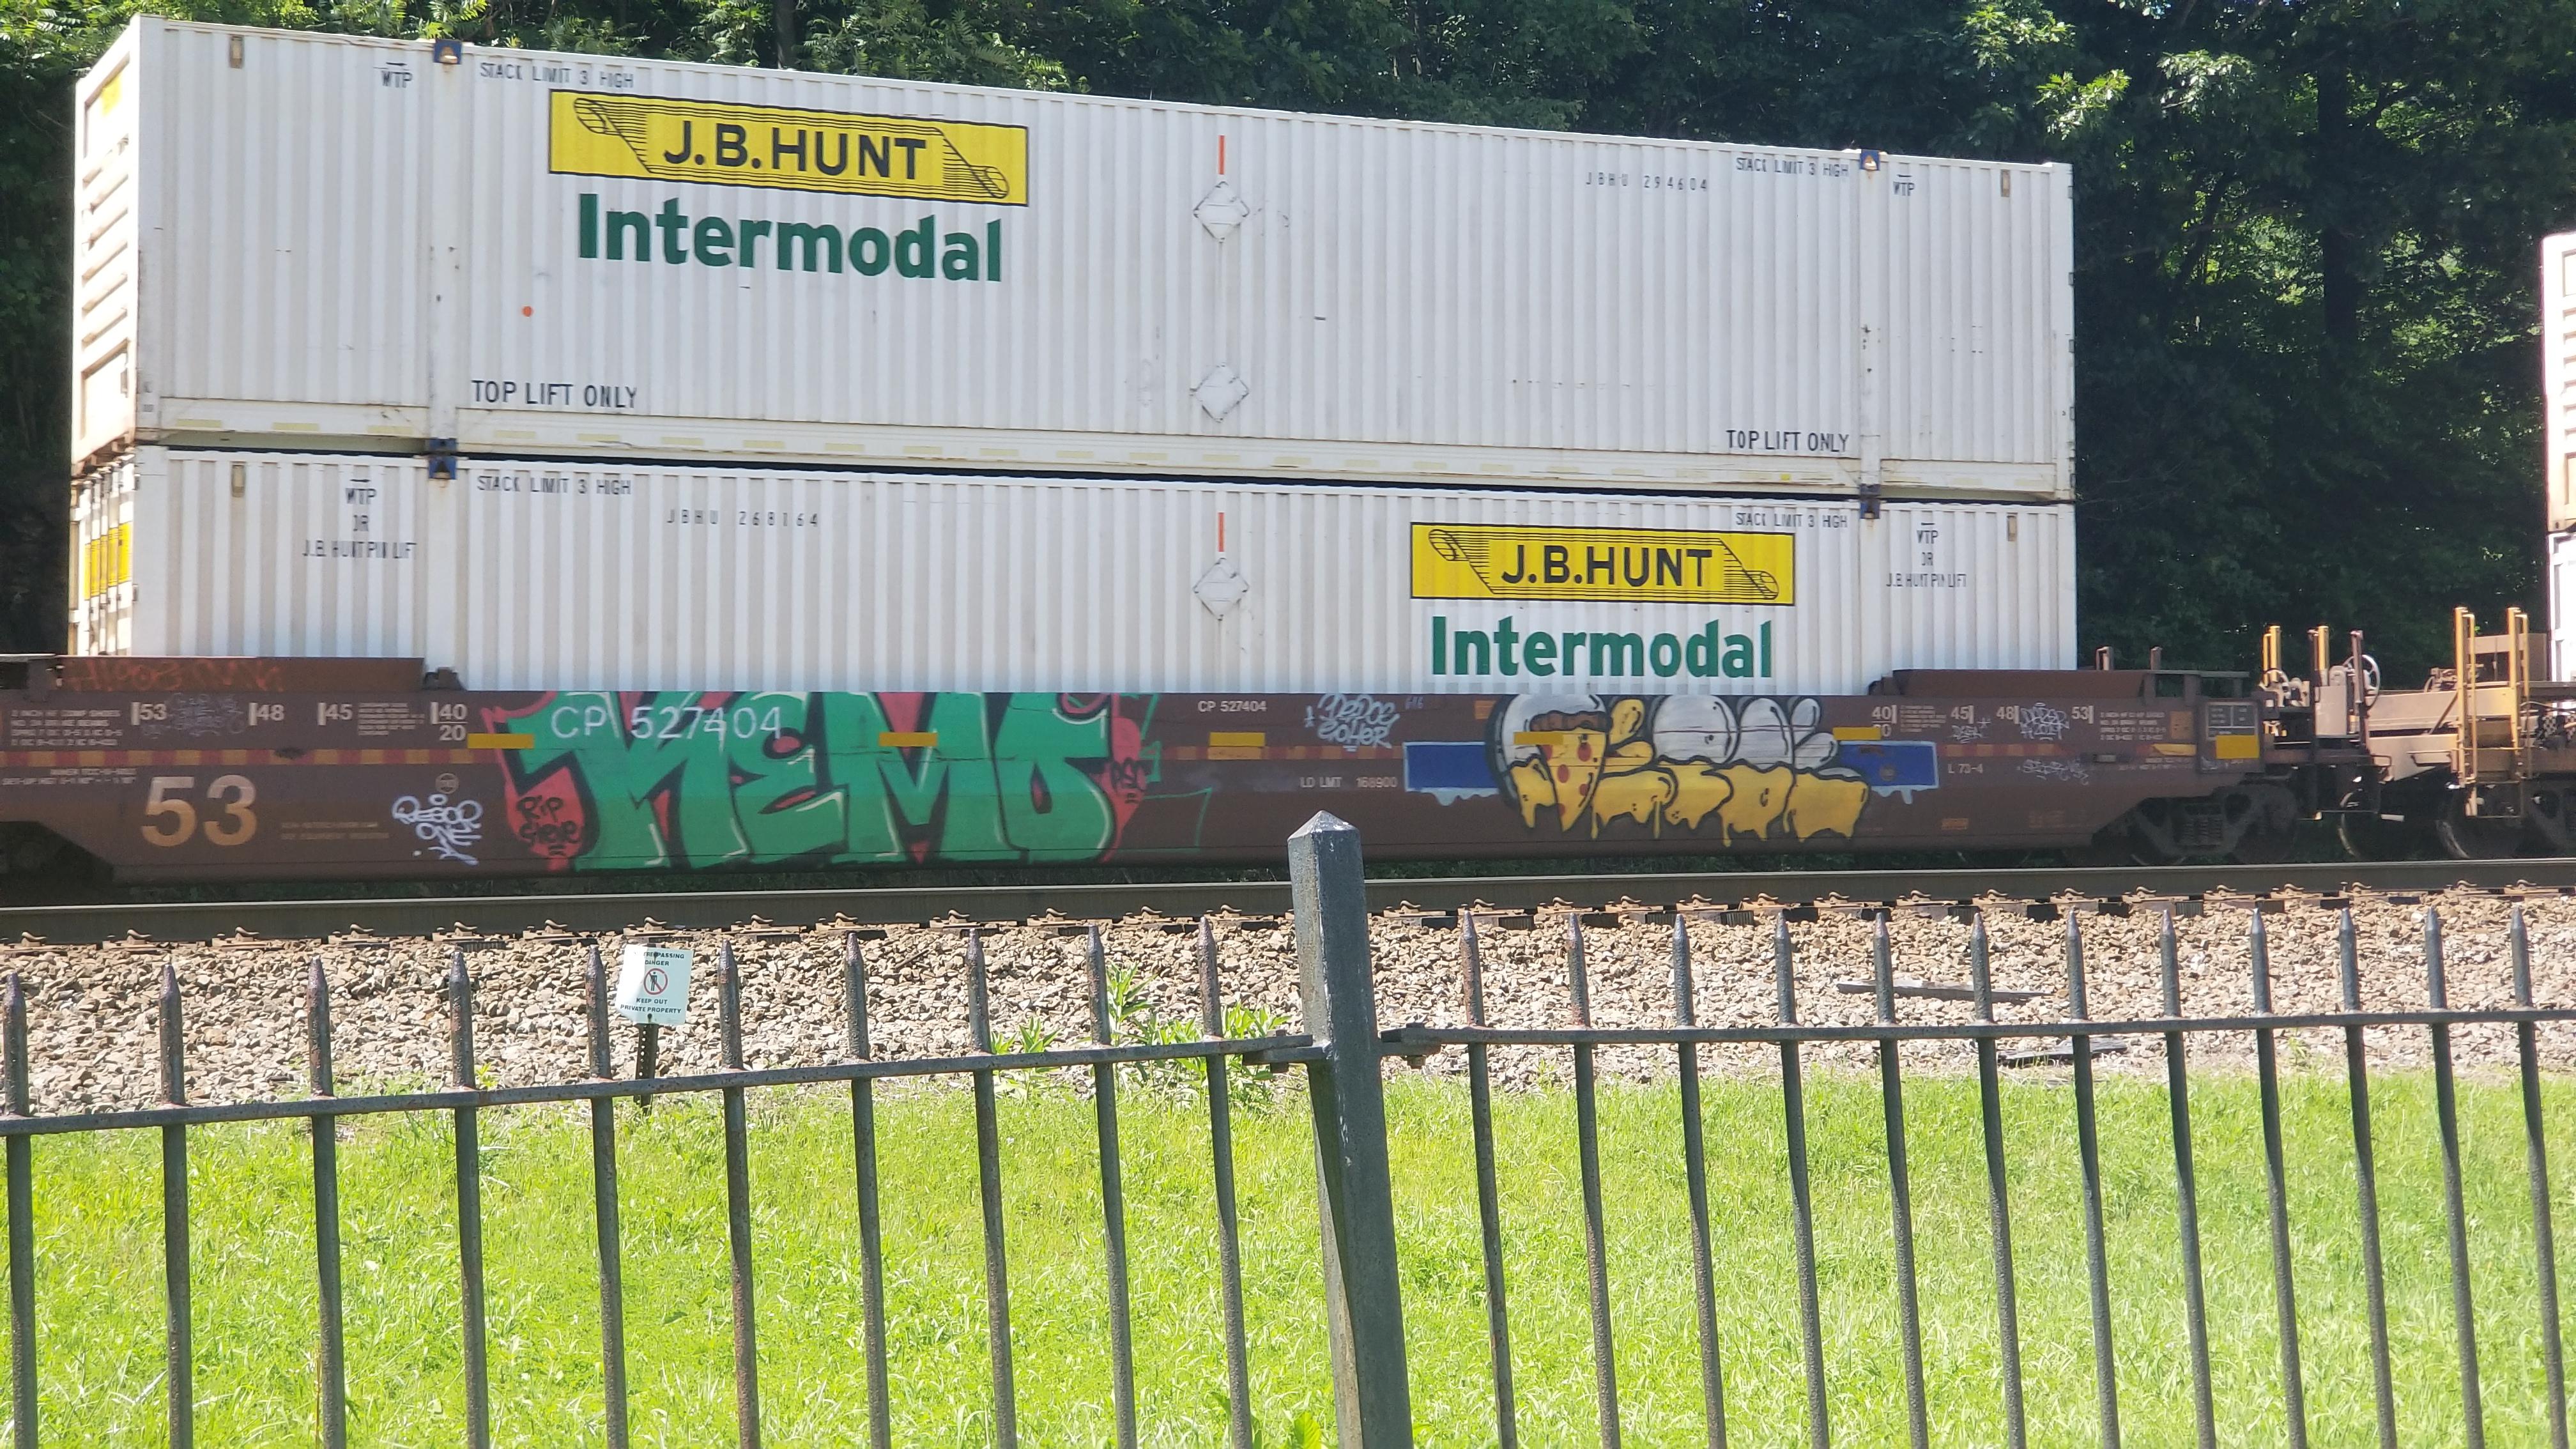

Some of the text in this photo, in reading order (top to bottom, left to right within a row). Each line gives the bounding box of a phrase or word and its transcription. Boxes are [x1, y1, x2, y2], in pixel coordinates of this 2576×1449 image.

[381, 71, 414, 88] WTP
[480, 63, 634, 89] STACK LIMIT 3 HIGH
[1736, 157, 1850, 177] STACK LIMIT 3 HIGH
[579, 194, 1002, 282] Intermodal
[471, 380, 637, 408] TOP LIFT ONLY
[1726, 430, 1850, 452] TOP LIFT ONLY
[477, 476, 631, 495] STACK LIMIT 3 HIGH
[1736, 512, 1848, 528] STACK LIMIT 3 HIGH
[1432, 616, 1772, 678] Intermodal
[140, 703, 167, 721] 53
[257, 704, 285, 721] 48
[326, 703, 353, 721] 45
[439, 703, 468, 720] 40
[1198, 700, 1268, 712] CP 527404
[1871, 706, 1892, 720] 40
[1951, 706, 1969, 720] 45
[1996, 706, 2014, 720] 48
[2071, 706, 2089, 720] 53
[551, 705, 781, 740] CP 527404
[1872, 724, 1892, 737] 0
[439, 724, 466, 741] 20
[141, 774, 257, 847] 53
[620, 1004, 646, 1012] PRIVATE
